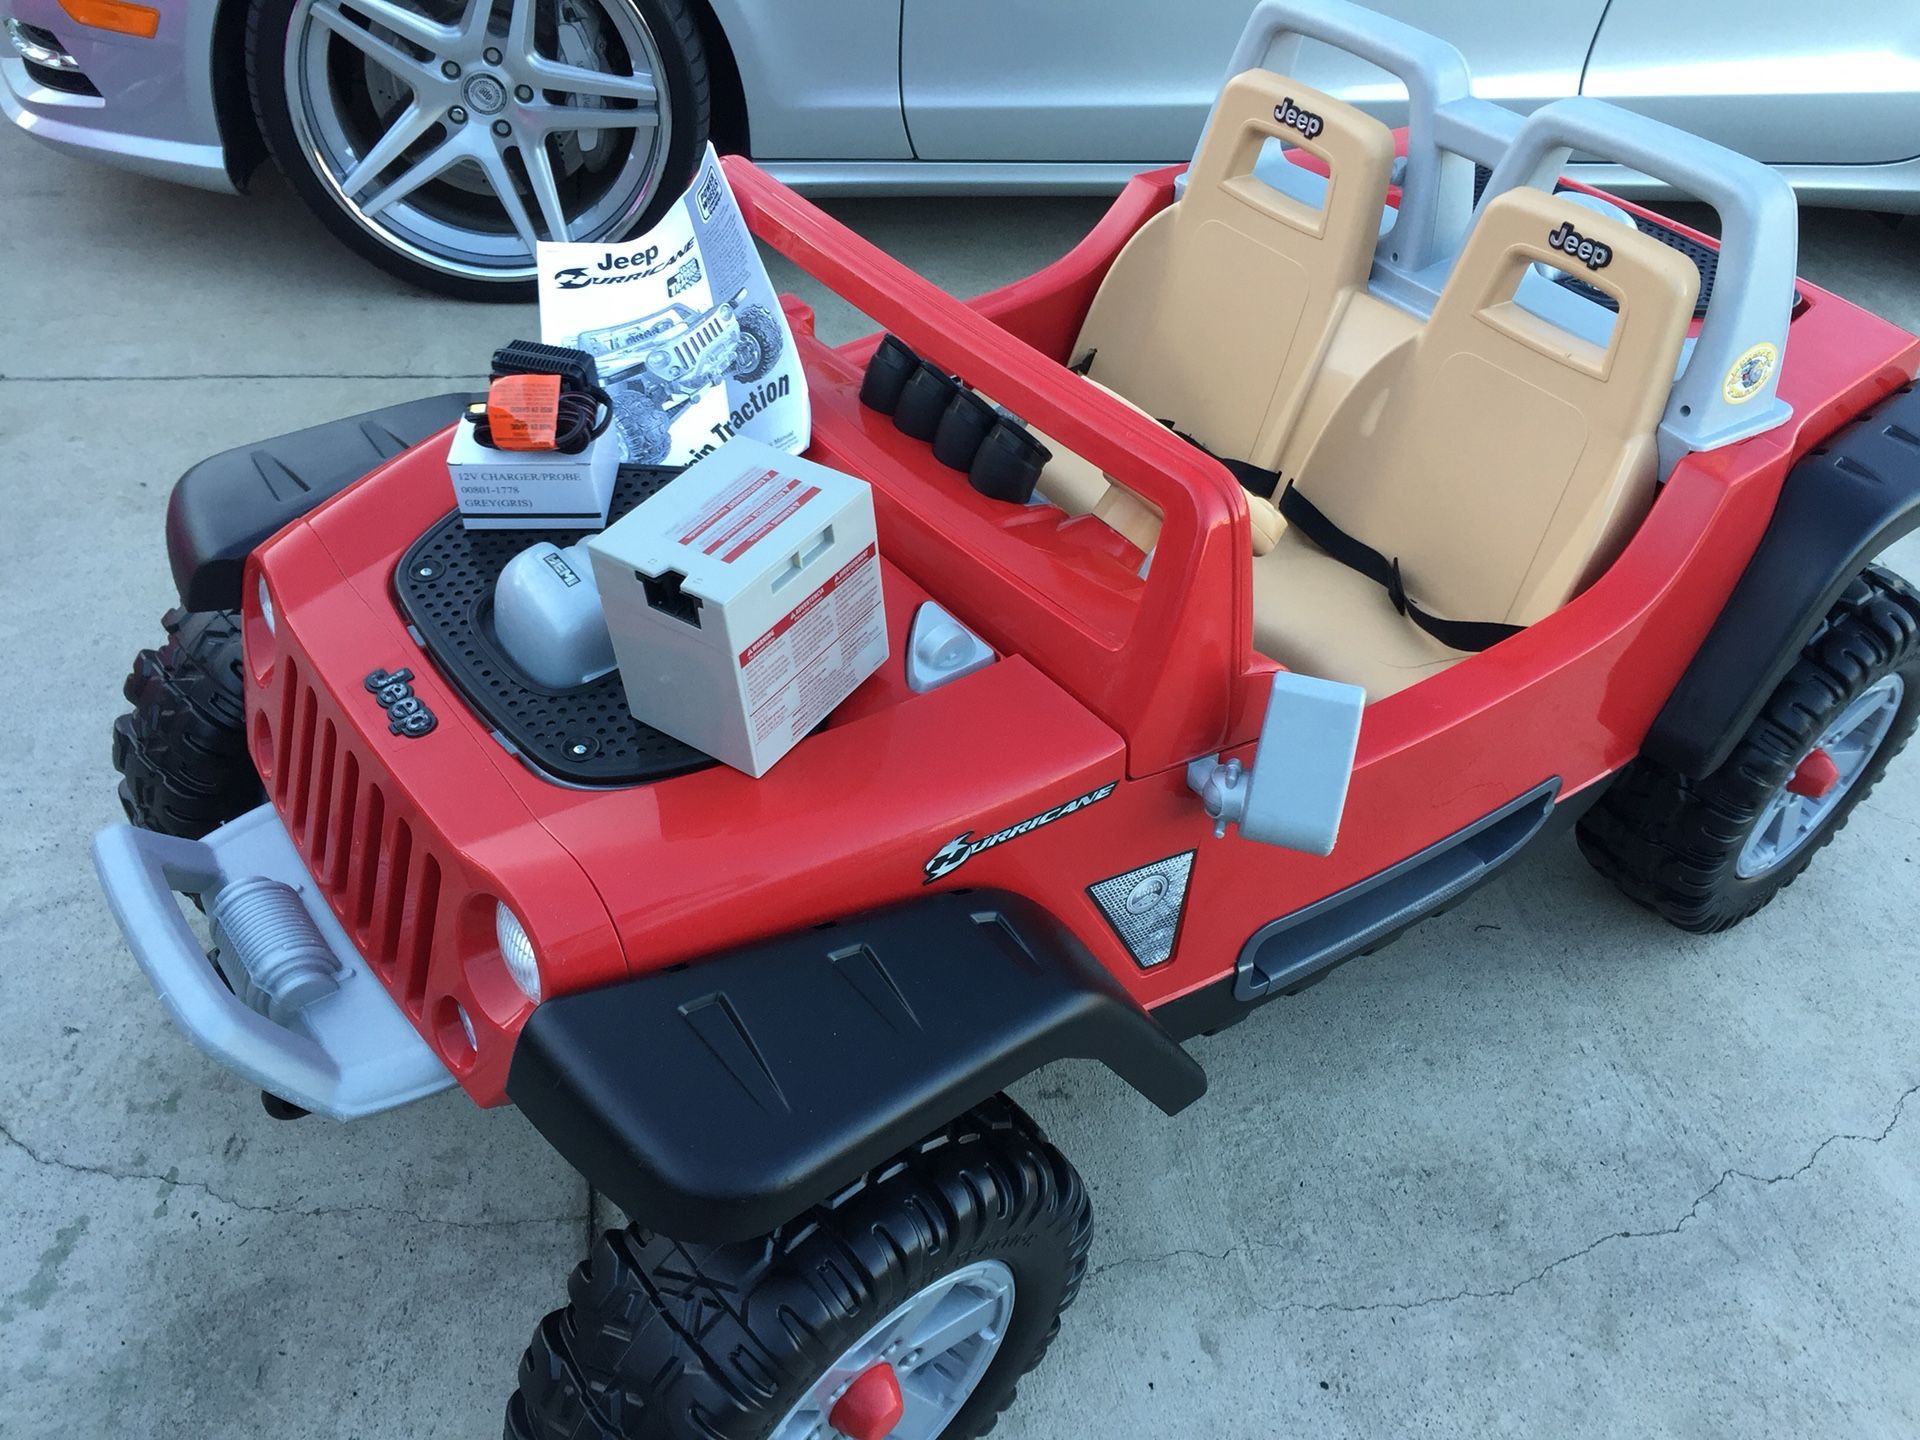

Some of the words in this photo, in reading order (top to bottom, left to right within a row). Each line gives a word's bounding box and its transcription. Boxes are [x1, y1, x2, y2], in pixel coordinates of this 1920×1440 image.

[1274, 98, 1322, 137] Jeep
[597, 245, 659, 271] Jeep
[1550, 223, 1611, 268] Jeep
[710, 374, 790, 443] Traction
[459, 472, 479, 481] 12V
[481, 472, 581, 481] CHARGER/PROBE
[544, 553, 580, 587] HEMI
[366, 668, 437, 736] Jeep
[922, 779, 1120, 886] HURRICANE
